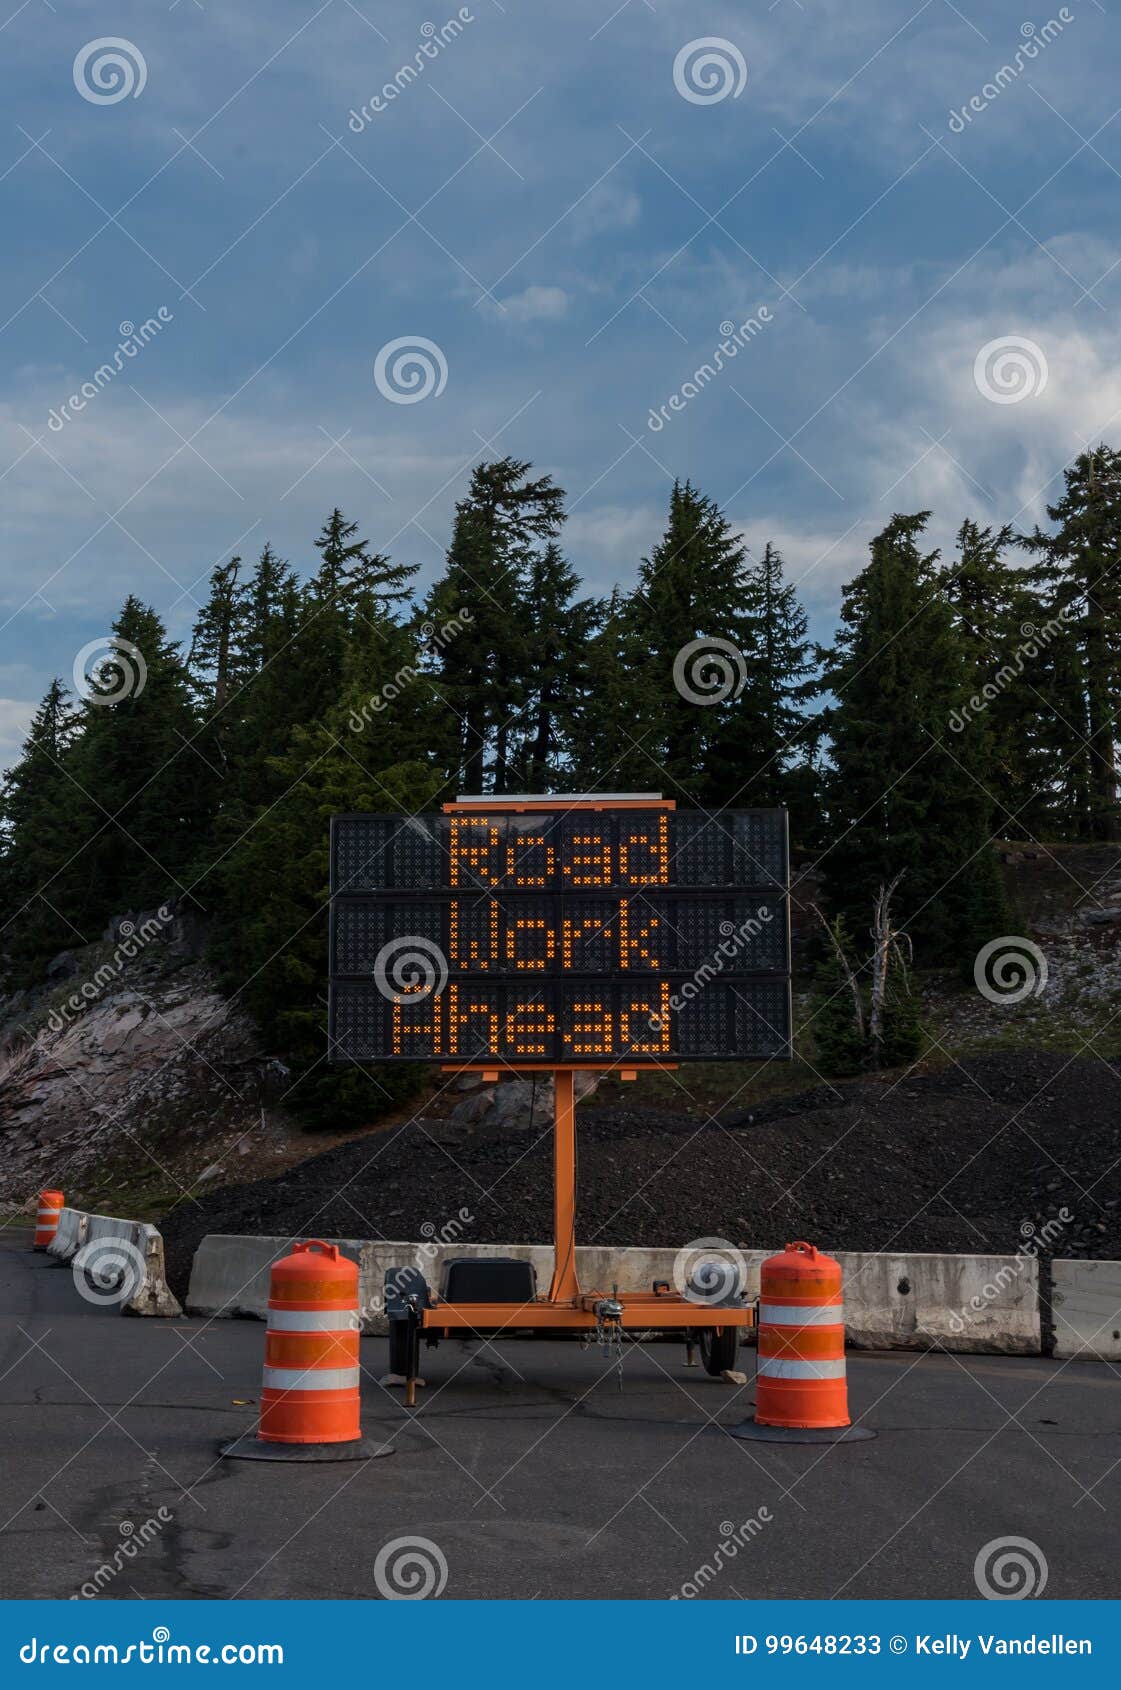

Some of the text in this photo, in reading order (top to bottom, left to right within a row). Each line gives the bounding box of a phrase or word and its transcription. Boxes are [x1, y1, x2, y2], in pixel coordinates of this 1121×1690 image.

[451, 816, 668, 886] Road
[451, 898, 659, 968] Work
[393, 982, 670, 1054] Ahead
